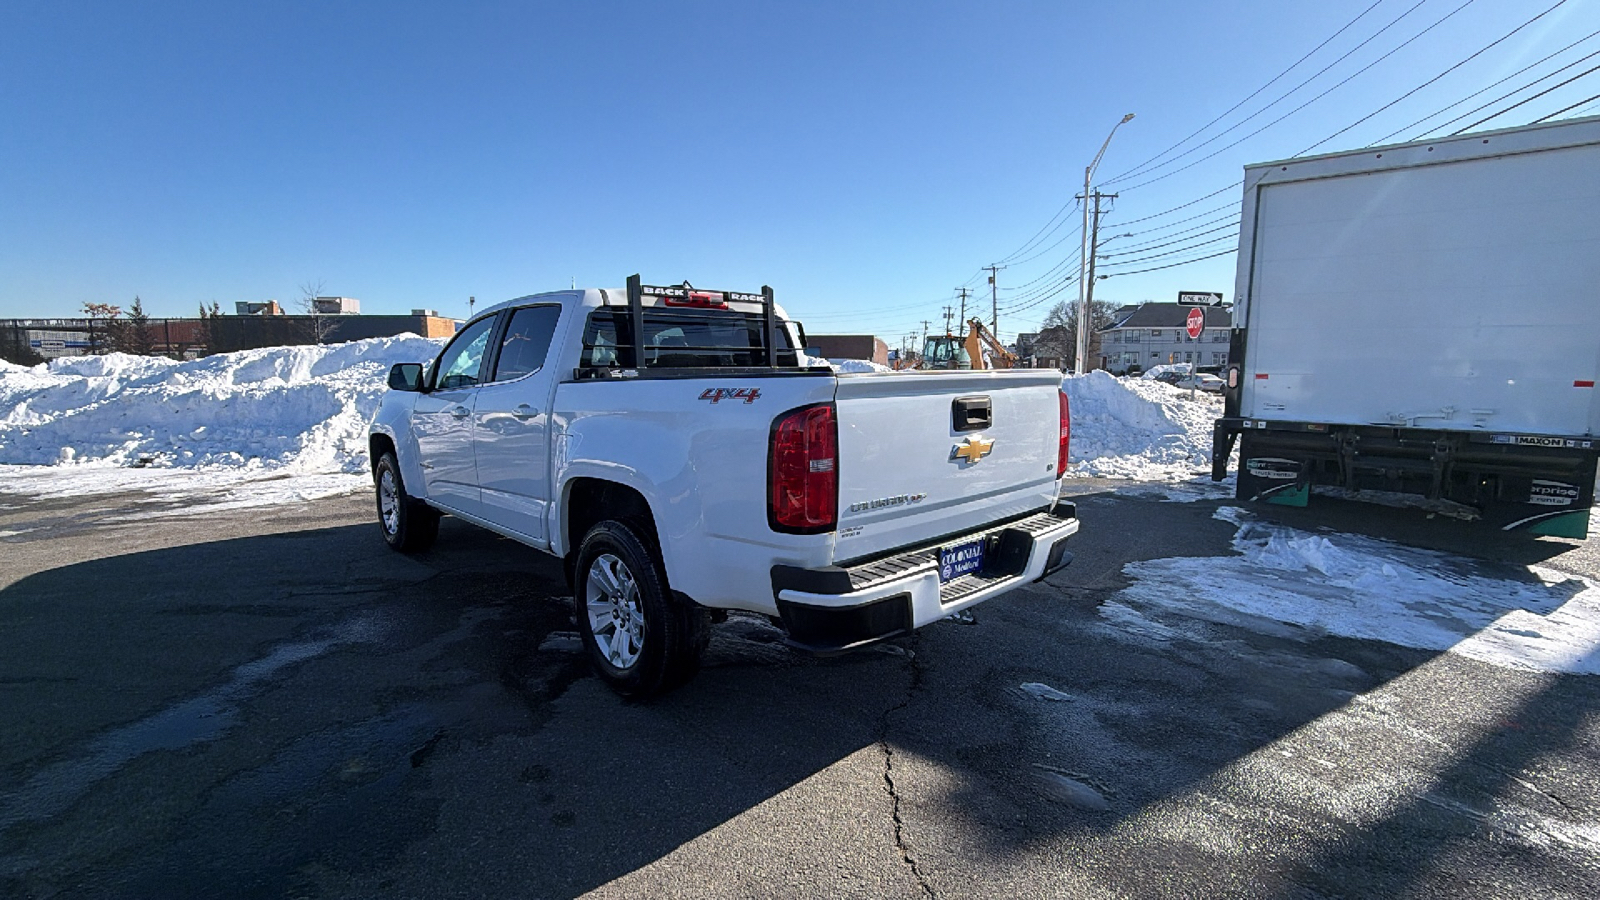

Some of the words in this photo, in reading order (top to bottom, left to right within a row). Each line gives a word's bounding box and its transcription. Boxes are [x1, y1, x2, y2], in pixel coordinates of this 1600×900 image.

[643, 287, 684, 296] BACK
[732, 293, 765, 302] RACK
[1187, 316, 1203, 329] STOP
[1520, 437, 1561, 446] MAXON
[942, 546, 982, 567] COLONIAL
